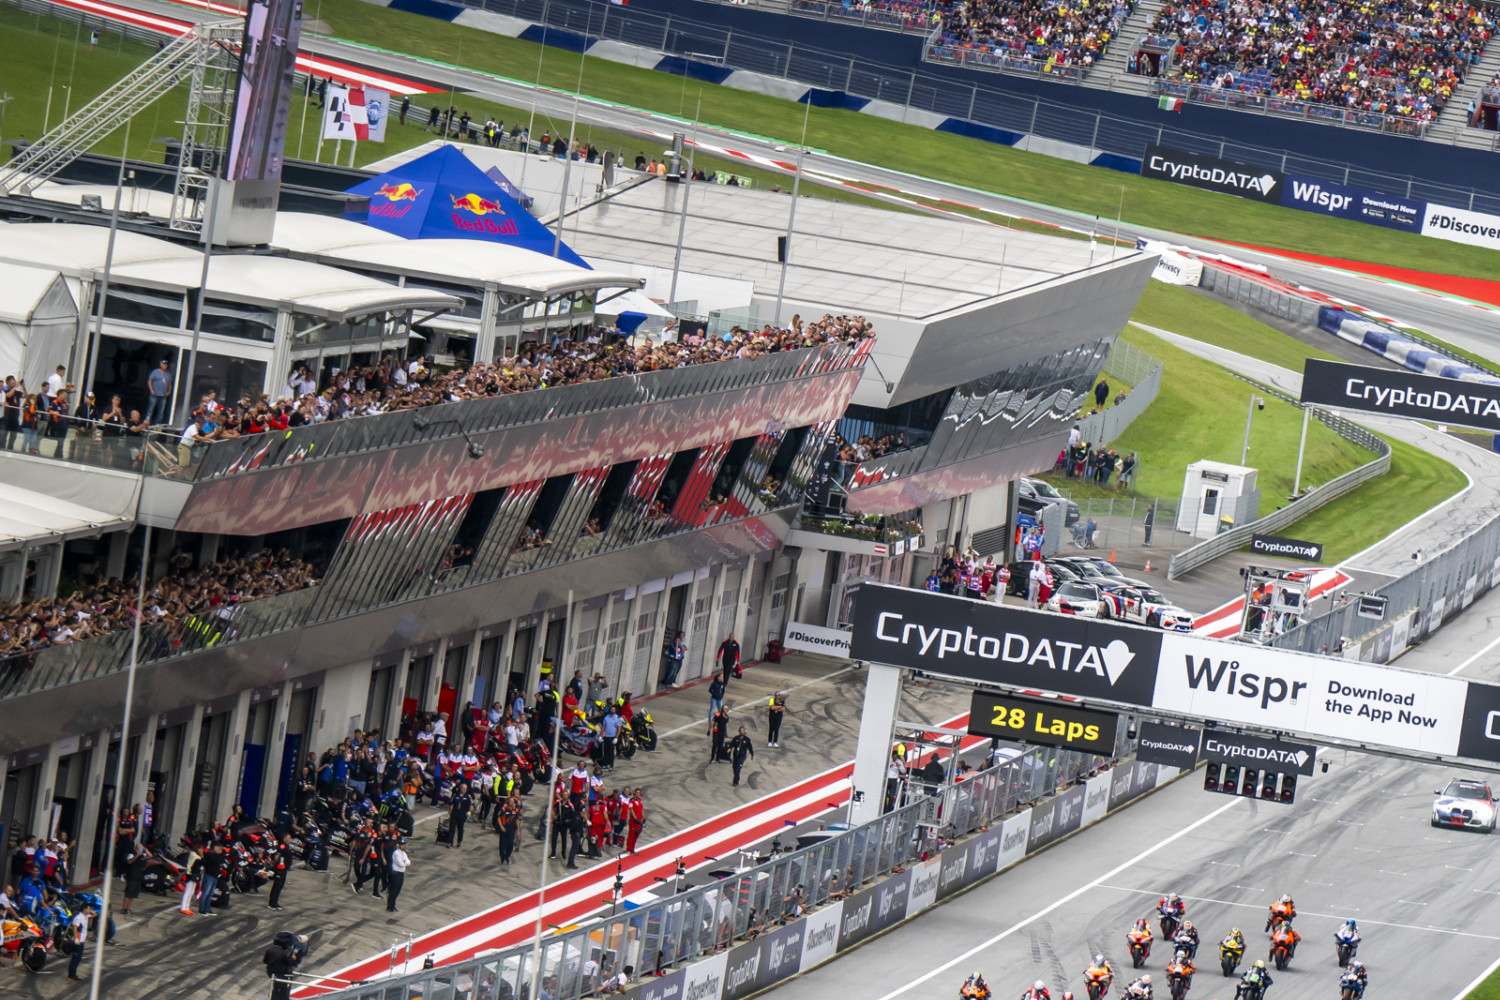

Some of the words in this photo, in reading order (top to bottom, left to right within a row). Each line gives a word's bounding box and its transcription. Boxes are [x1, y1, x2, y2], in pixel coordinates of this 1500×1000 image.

[1150, 156, 1262, 192] CryptoDATA
[1292, 181, 1352, 211] Wispr
[1362, 197, 1399, 211] Download
[1400, 205, 1417, 215] Now
[382, 205, 412, 218] Bull
[452, 213, 484, 232] Red
[486, 217, 518, 235] Bull
[1254, 540, 1311, 557] CryptoDATA
[876, 611, 1105, 676] CryptoDATA
[1185, 654, 1307, 709] Wispr
[1327, 680, 1415, 707] Download
[991, 705, 1026, 729] 28
[1034, 712, 1099, 742] Laps
[1325, 699, 1353, 715] the
[1357, 703, 1393, 724] App
[1398, 710, 1438, 728] Now
[1141, 739, 1189, 752] CryptoDATA
[1206, 740, 1297, 764] CryptoDATA
